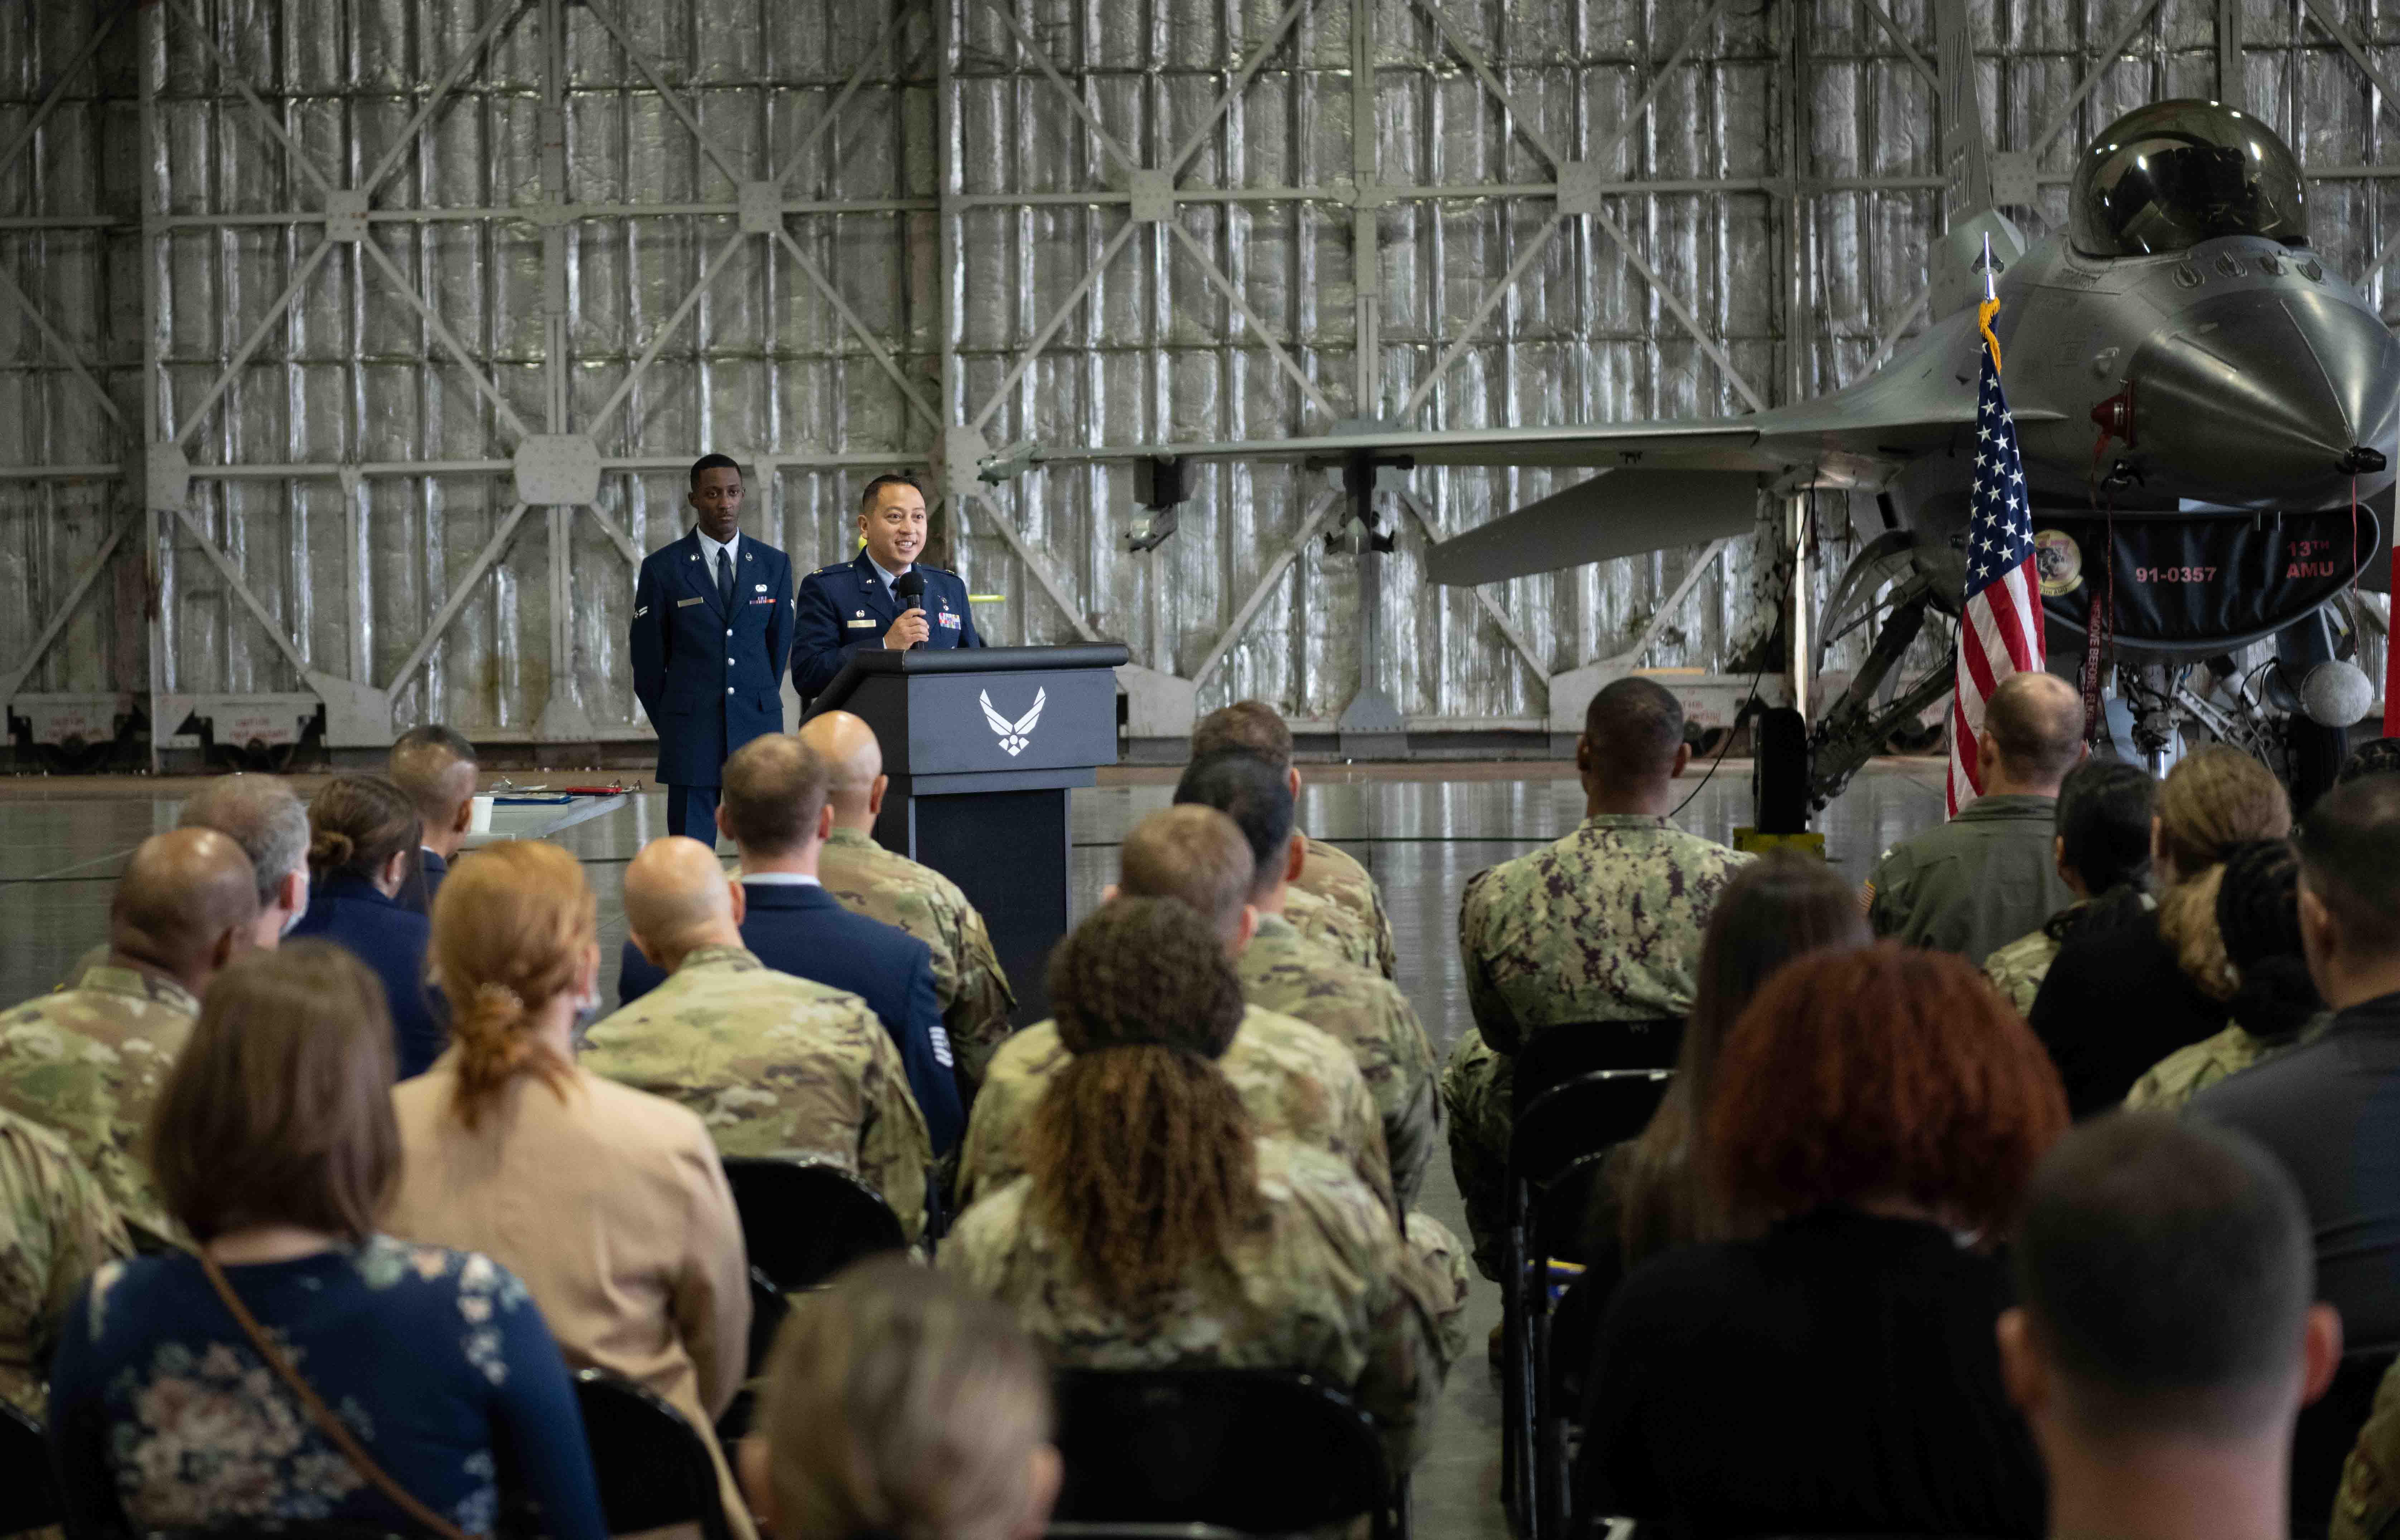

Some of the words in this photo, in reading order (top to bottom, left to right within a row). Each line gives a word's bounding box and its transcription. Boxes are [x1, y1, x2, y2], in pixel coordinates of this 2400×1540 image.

[2287, 540, 2329, 556] 13TH
[2136, 567, 2217, 583] 91-0357
[2286, 561, 2334, 579] AMU
